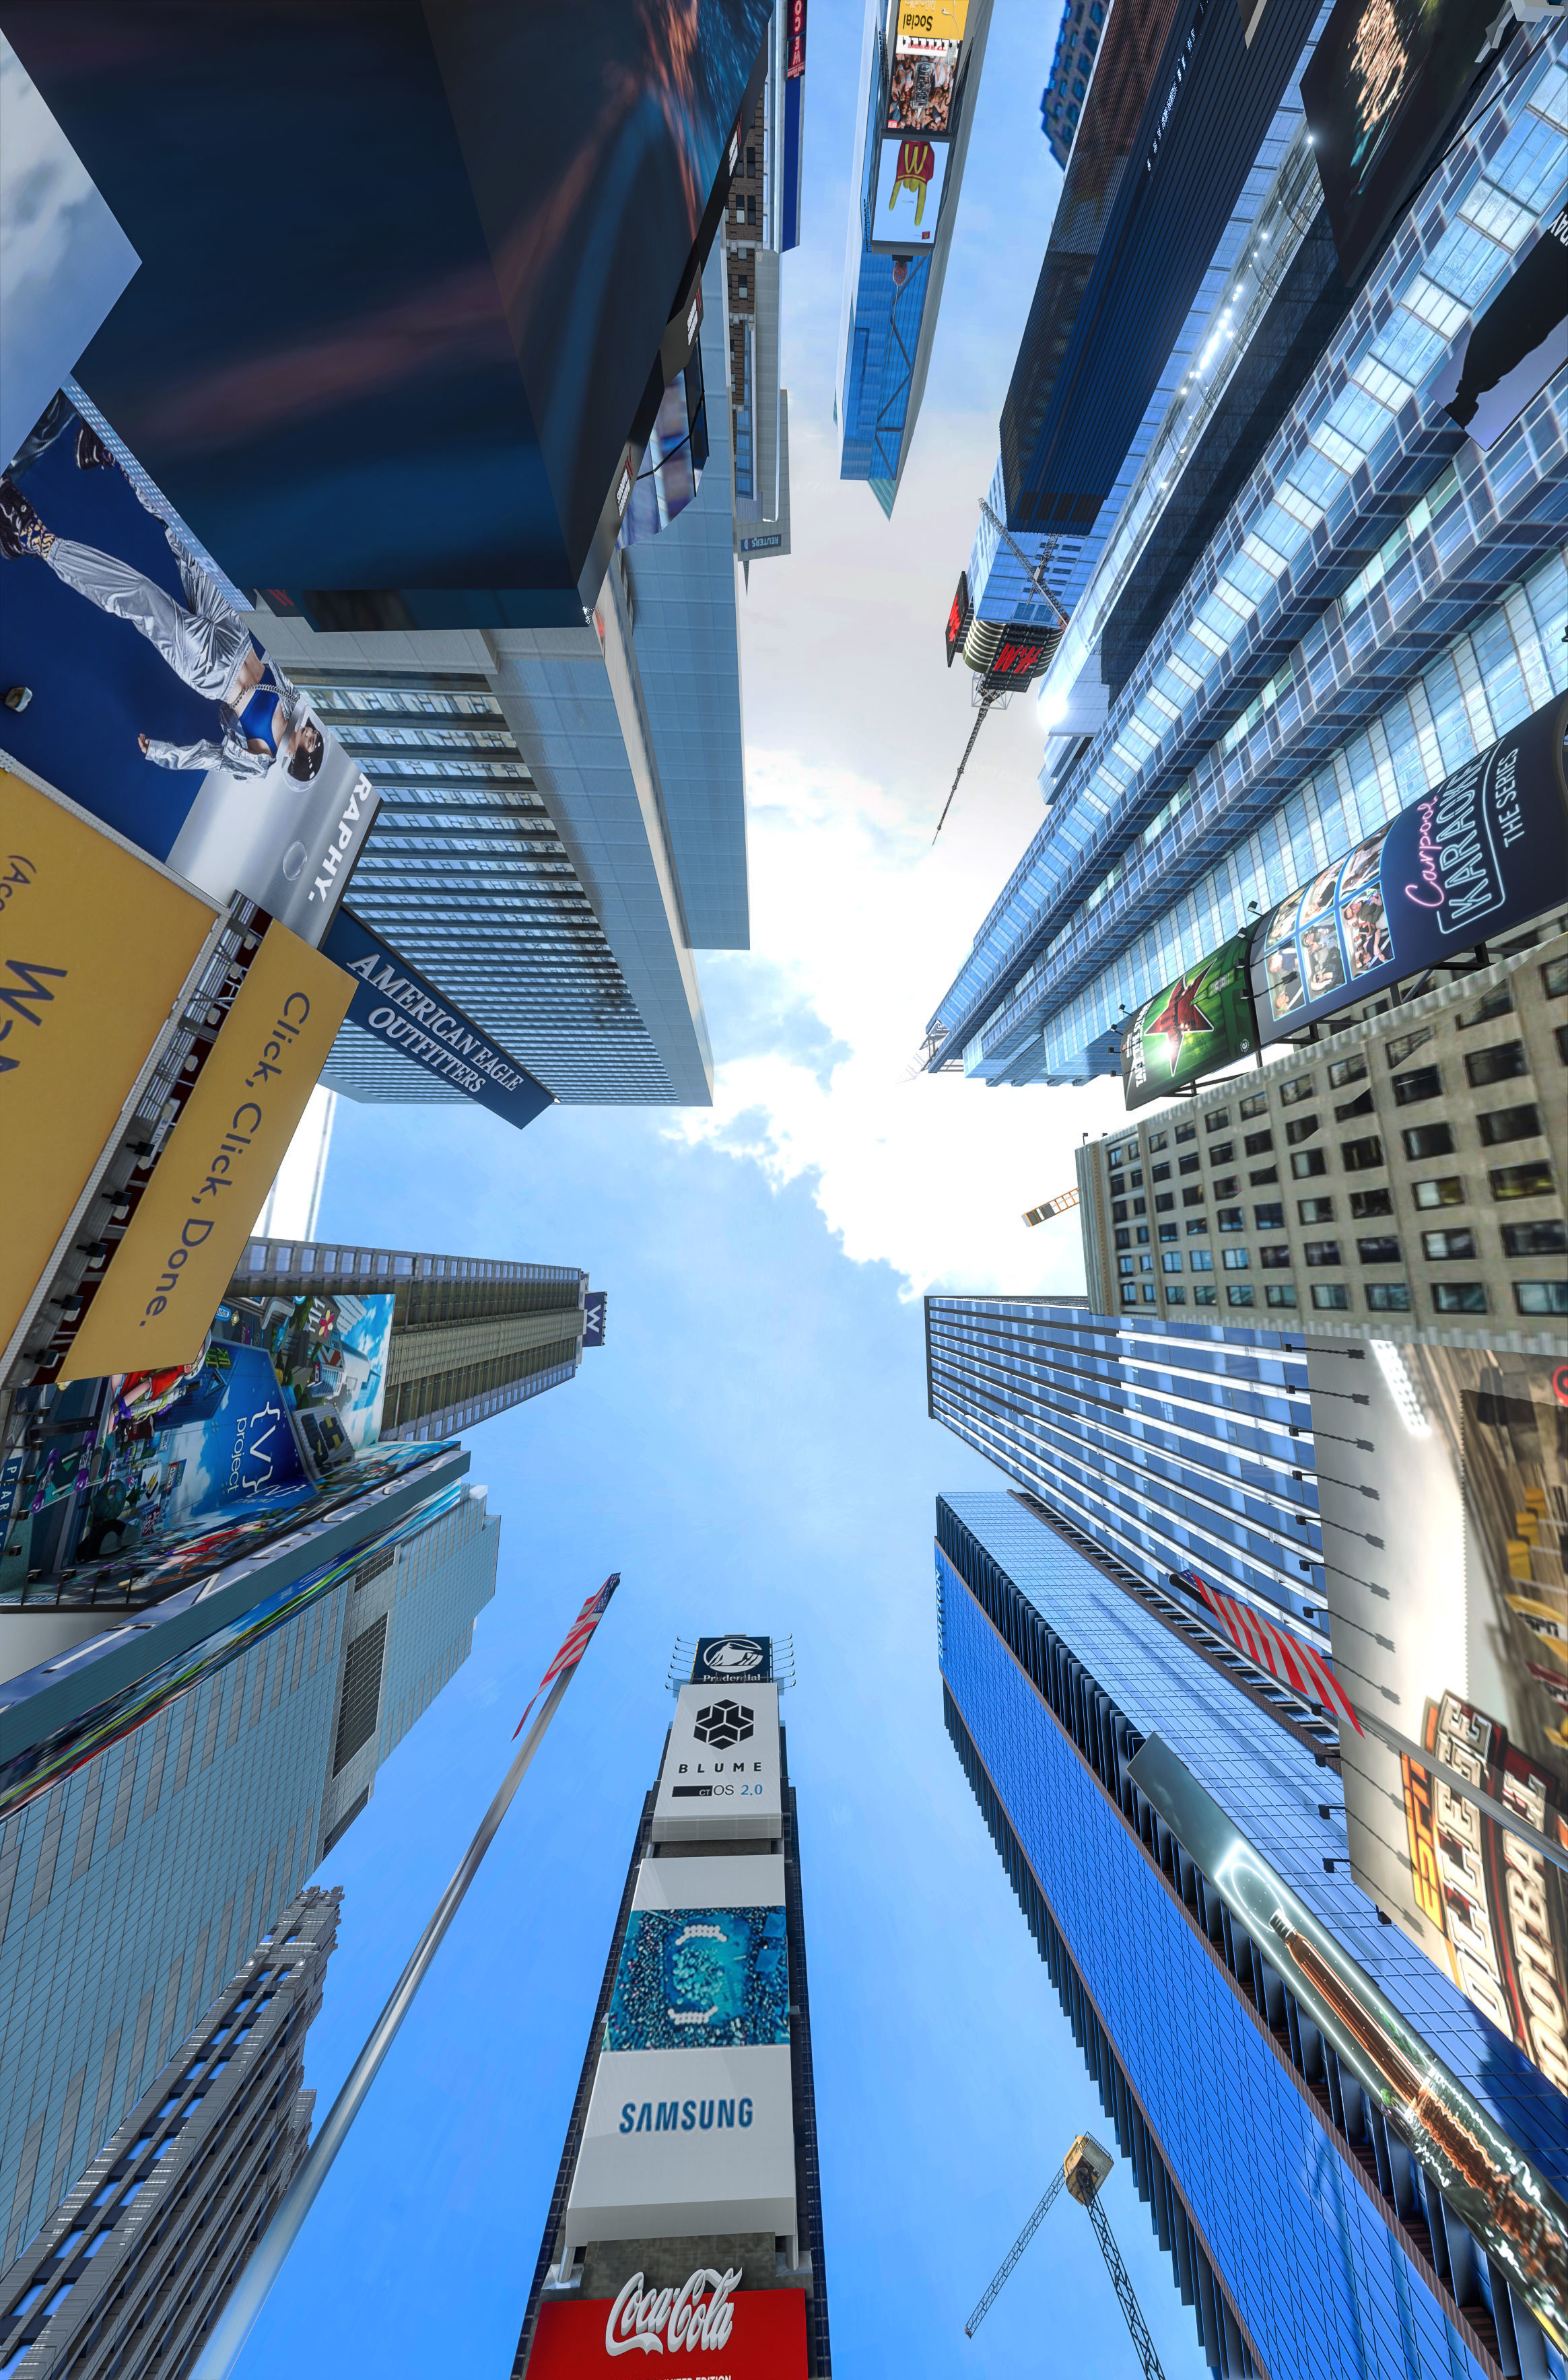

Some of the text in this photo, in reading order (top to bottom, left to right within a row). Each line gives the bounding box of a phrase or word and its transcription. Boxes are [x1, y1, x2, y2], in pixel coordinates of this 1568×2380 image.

[902, 13, 933, 32] Social
[1548, 211, 1568, 247] DAY
[751, 536, 779, 548] REUTERS
[993, 643, 1042, 674] H&M
[1495, 748, 1525, 848] THE SERIES
[1404, 795, 1445, 907] Carpool
[1435, 750, 1492, 919] KARAOKE
[345, 953, 524, 1092] AMERICAN EAGLE
[368, 1006, 486, 1092] OUTFITTERS
[139, 991, 310, 1327] Click, Click, Done.
[586, 1304, 601, 1333] W
[228, 1417, 248, 1492] project
[703, 1673, 761, 1682] Prudenial
[678, 1761, 762, 1774] BLUME
[740, 1784, 763, 1796] 2.0
[619, 2097, 753, 2134] SAMSUNG
